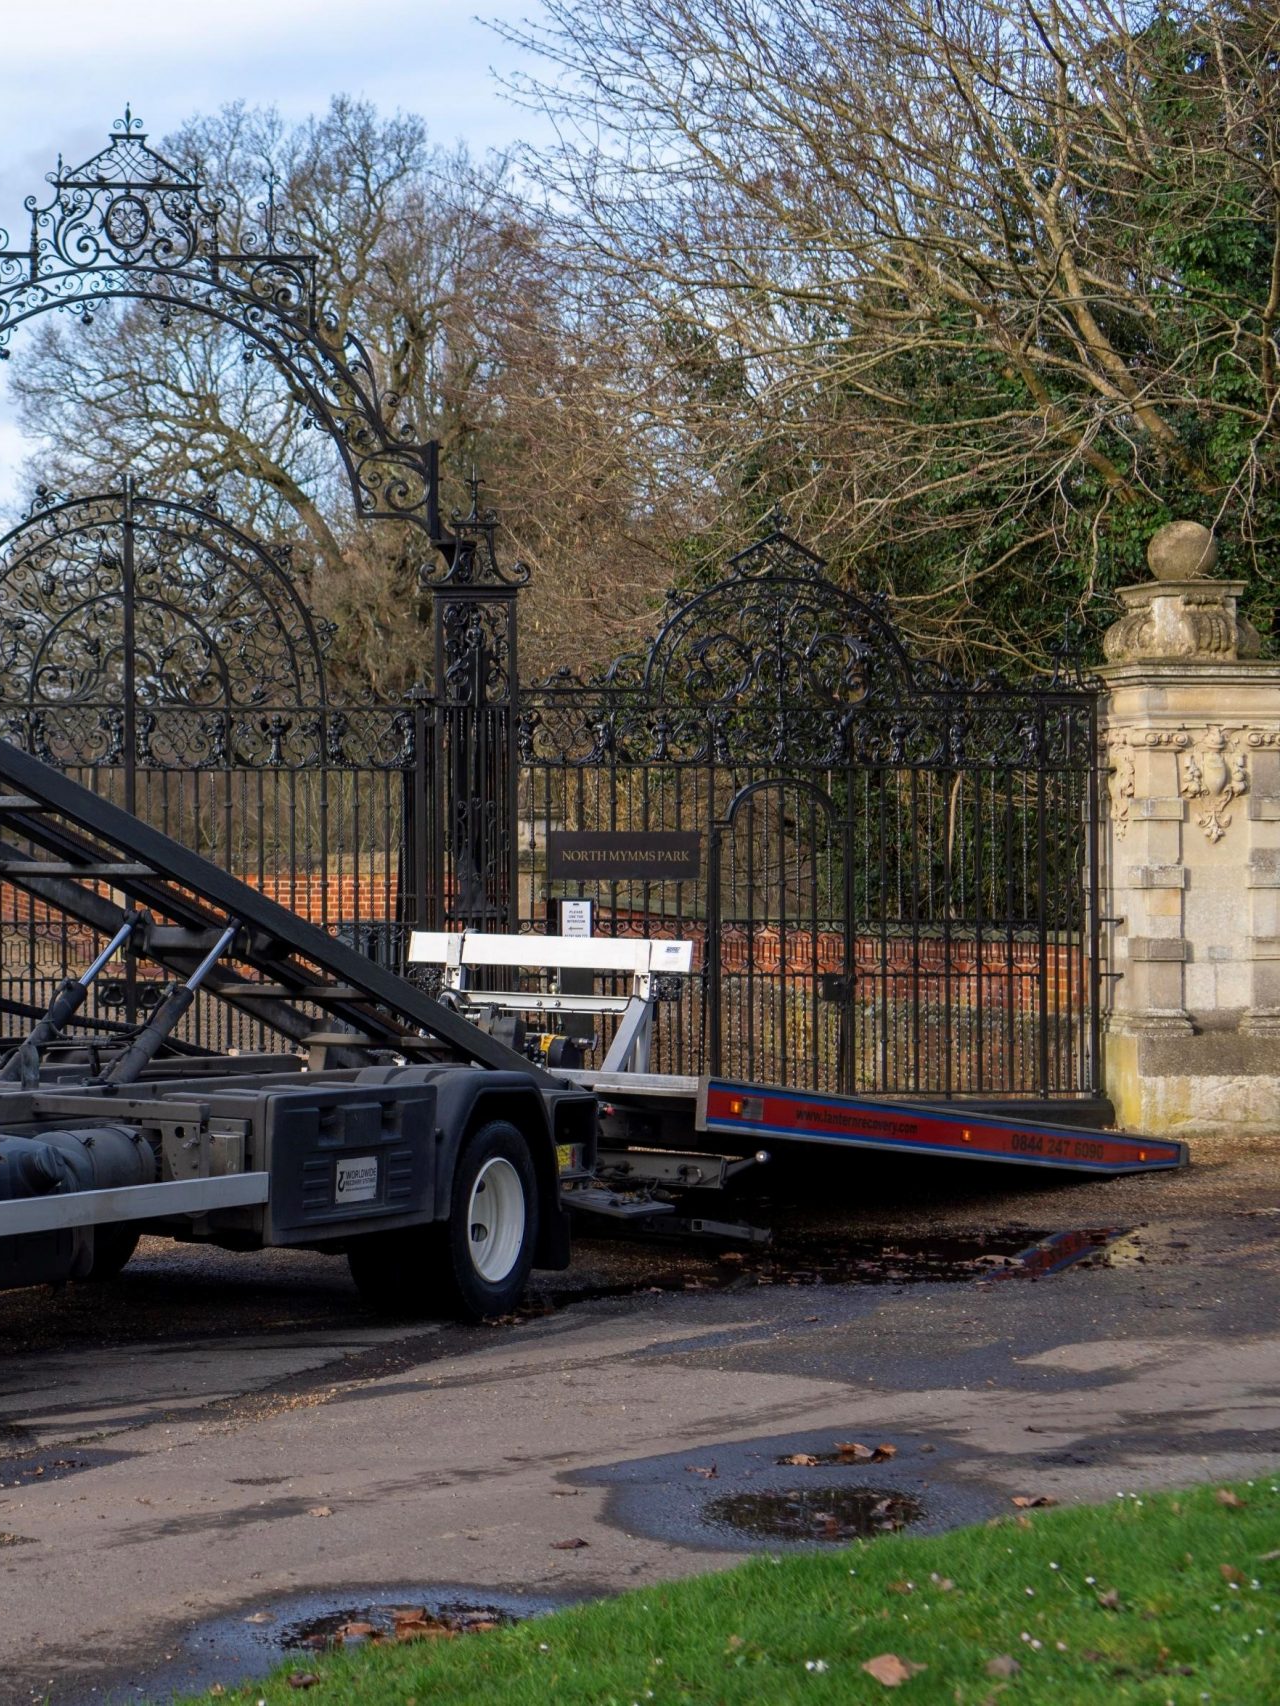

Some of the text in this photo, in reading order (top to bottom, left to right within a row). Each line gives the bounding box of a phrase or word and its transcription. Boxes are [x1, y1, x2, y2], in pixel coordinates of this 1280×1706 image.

[562, 850, 689, 861] NORTH MYMMS PARK
[796, 1109, 918, 1135] www.lanternrecovery.com
[1011, 1133, 1043, 1153] 0844
[1048, 1138, 1072, 1155] 247
[346, 1168, 377, 1180] WORLDWIDE
